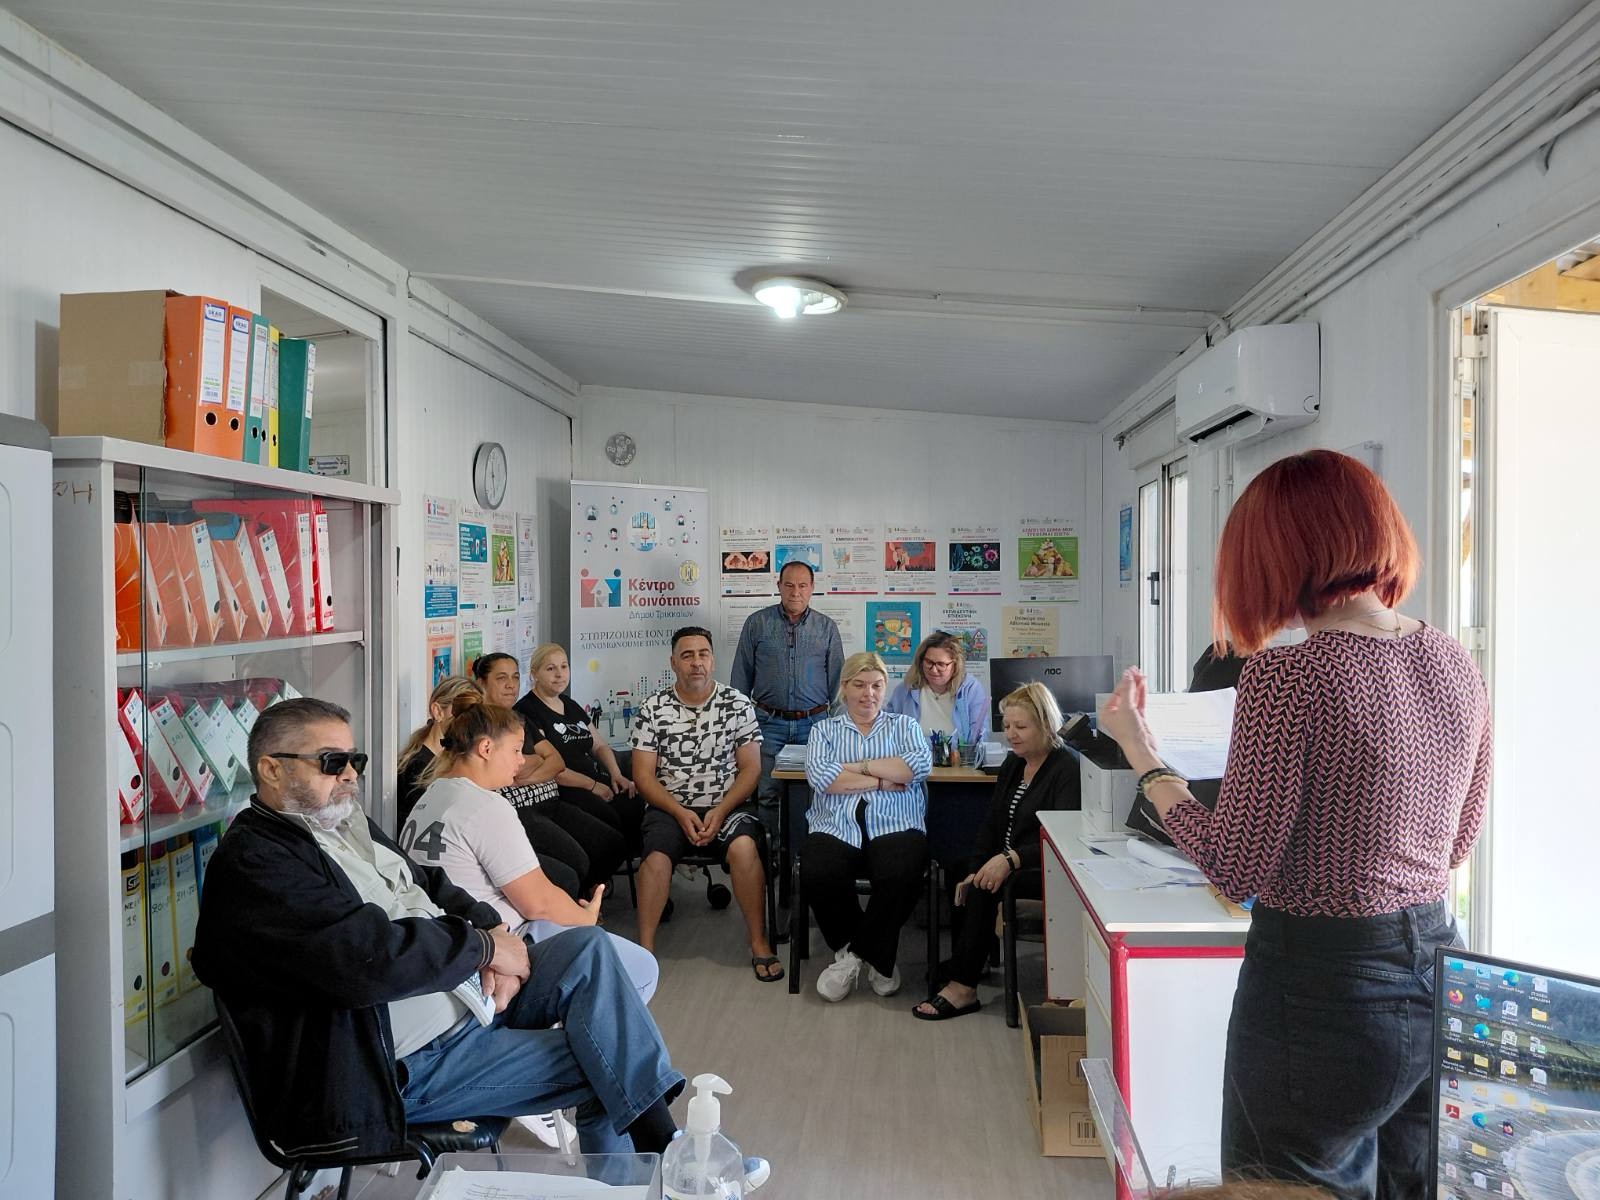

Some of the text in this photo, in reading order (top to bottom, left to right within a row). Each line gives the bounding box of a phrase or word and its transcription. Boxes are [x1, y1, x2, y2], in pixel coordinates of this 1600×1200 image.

[628, 578, 675, 593] Κέντρο
[628, 594, 700, 607] Κοινότητας
[629, 610, 694, 620] Δήμου Τρικκαίων
